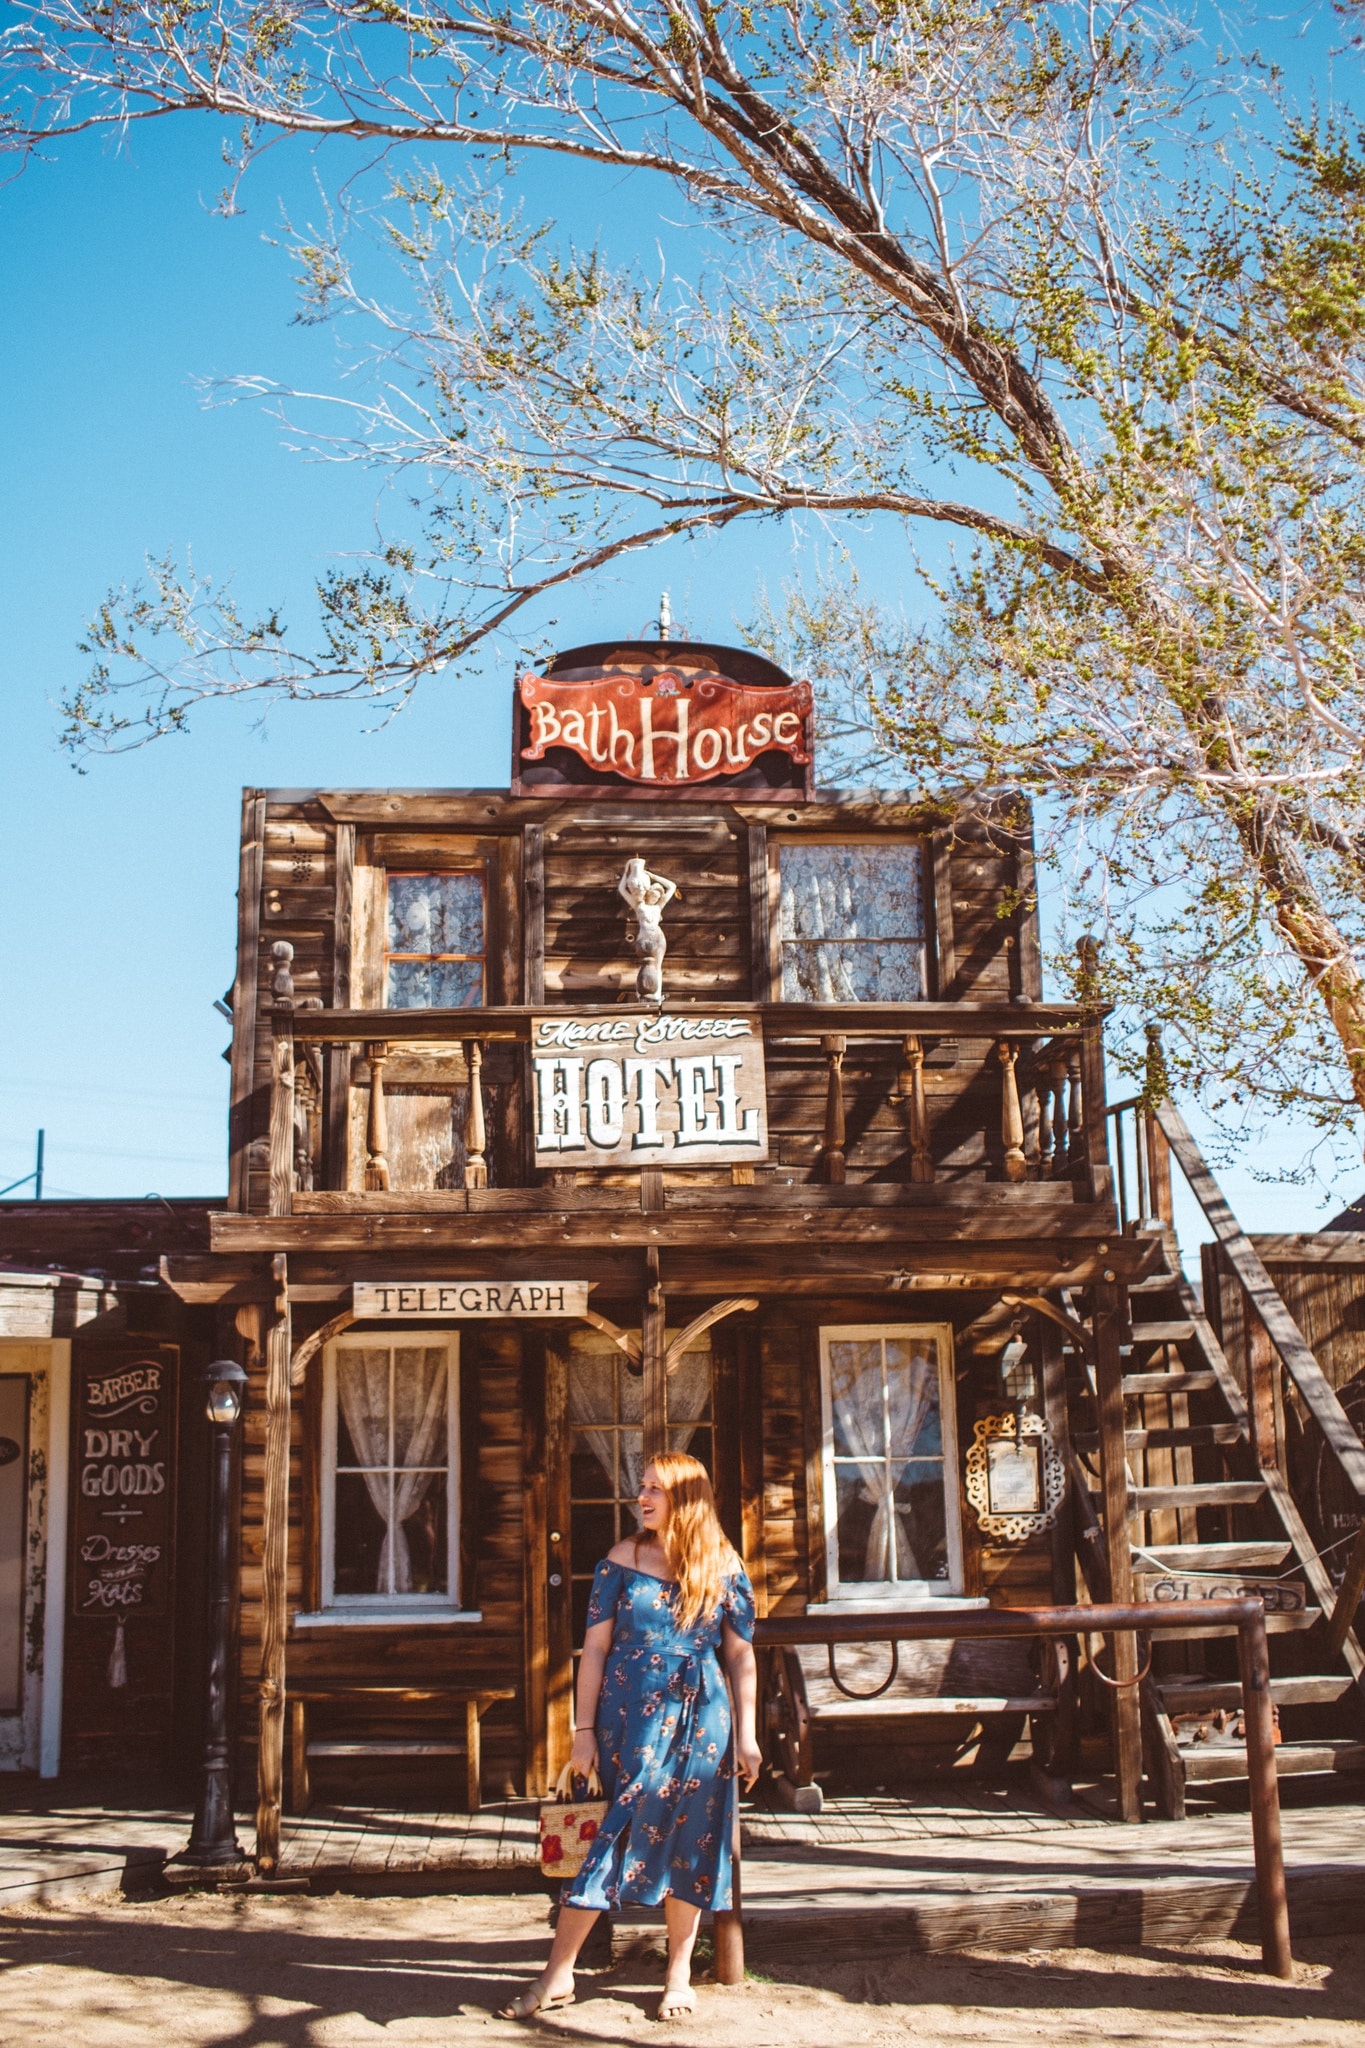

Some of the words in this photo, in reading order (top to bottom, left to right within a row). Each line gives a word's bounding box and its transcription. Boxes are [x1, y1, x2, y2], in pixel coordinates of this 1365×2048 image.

[536, 1020, 634, 1049] Mane
[633, 1015, 752, 1054] Street
[534, 1054, 761, 1153] HOTEL
[375, 1287, 565, 1312] TELEGRAPH
[87, 1368, 161, 1406] BARBER
[84, 1429, 159, 1458] DRY
[81, 1462, 165, 1496] GOODS
[80, 1534, 161, 1563] Dresses
[83, 1580, 143, 1607] Hats
